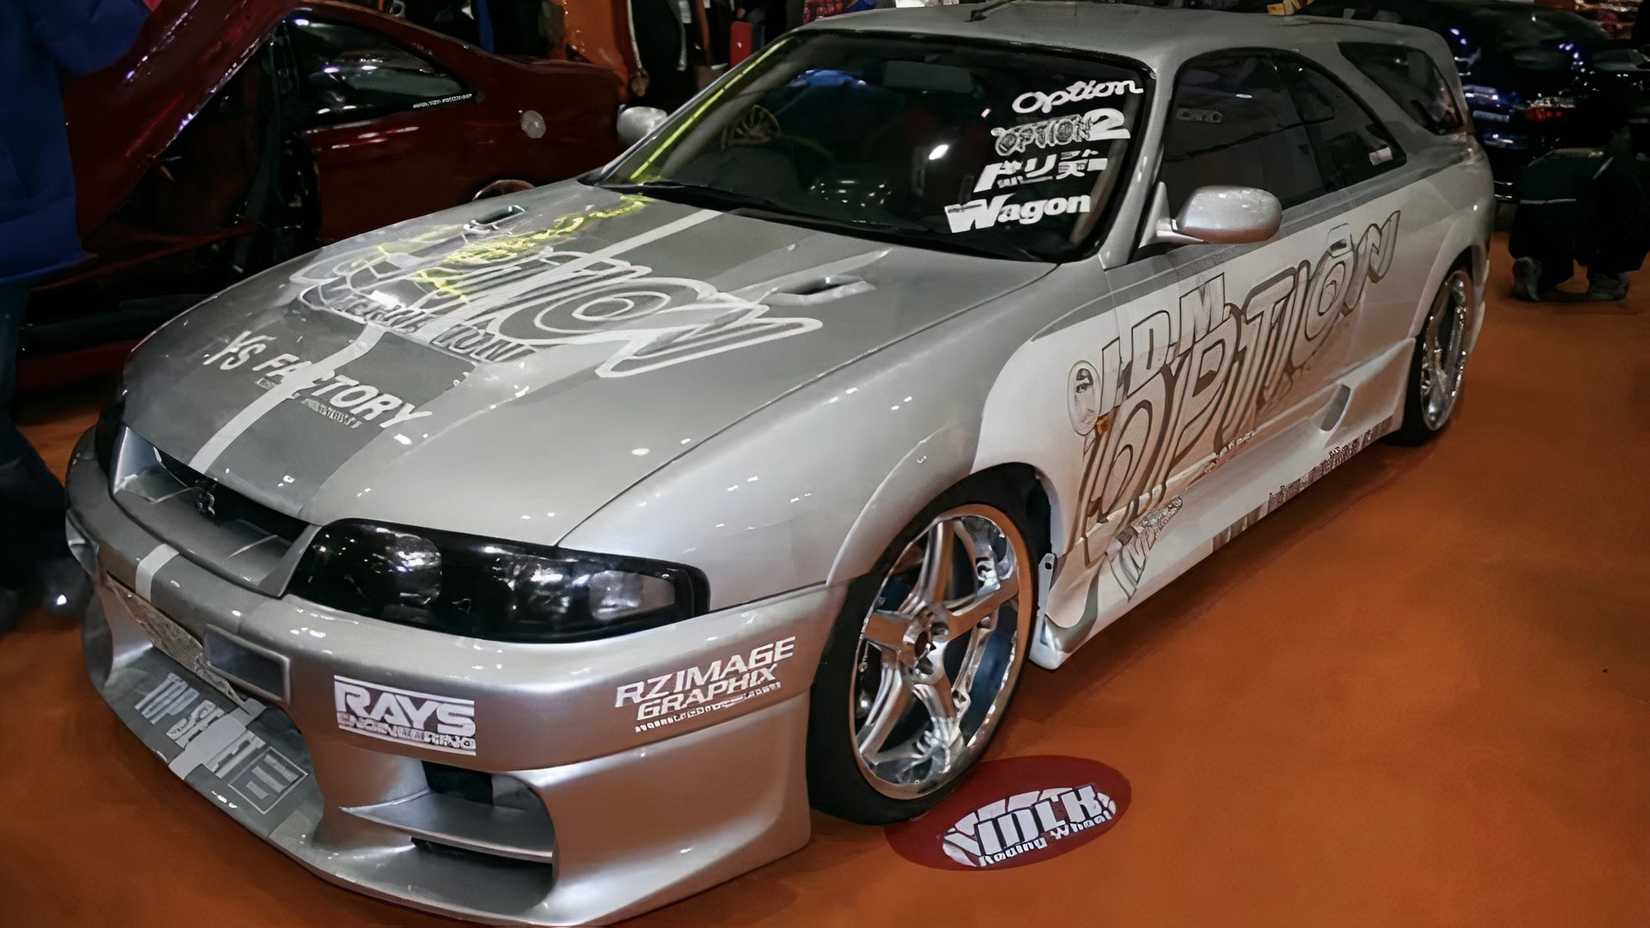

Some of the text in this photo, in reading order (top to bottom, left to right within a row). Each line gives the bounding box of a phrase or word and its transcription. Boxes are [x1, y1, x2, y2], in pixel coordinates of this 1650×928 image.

[1012, 80, 1144, 113] Option
[944, 192, 1091, 234] Wagon
[334, 680, 476, 738] RAYS
[637, 663, 777, 721] GRAPHIX
